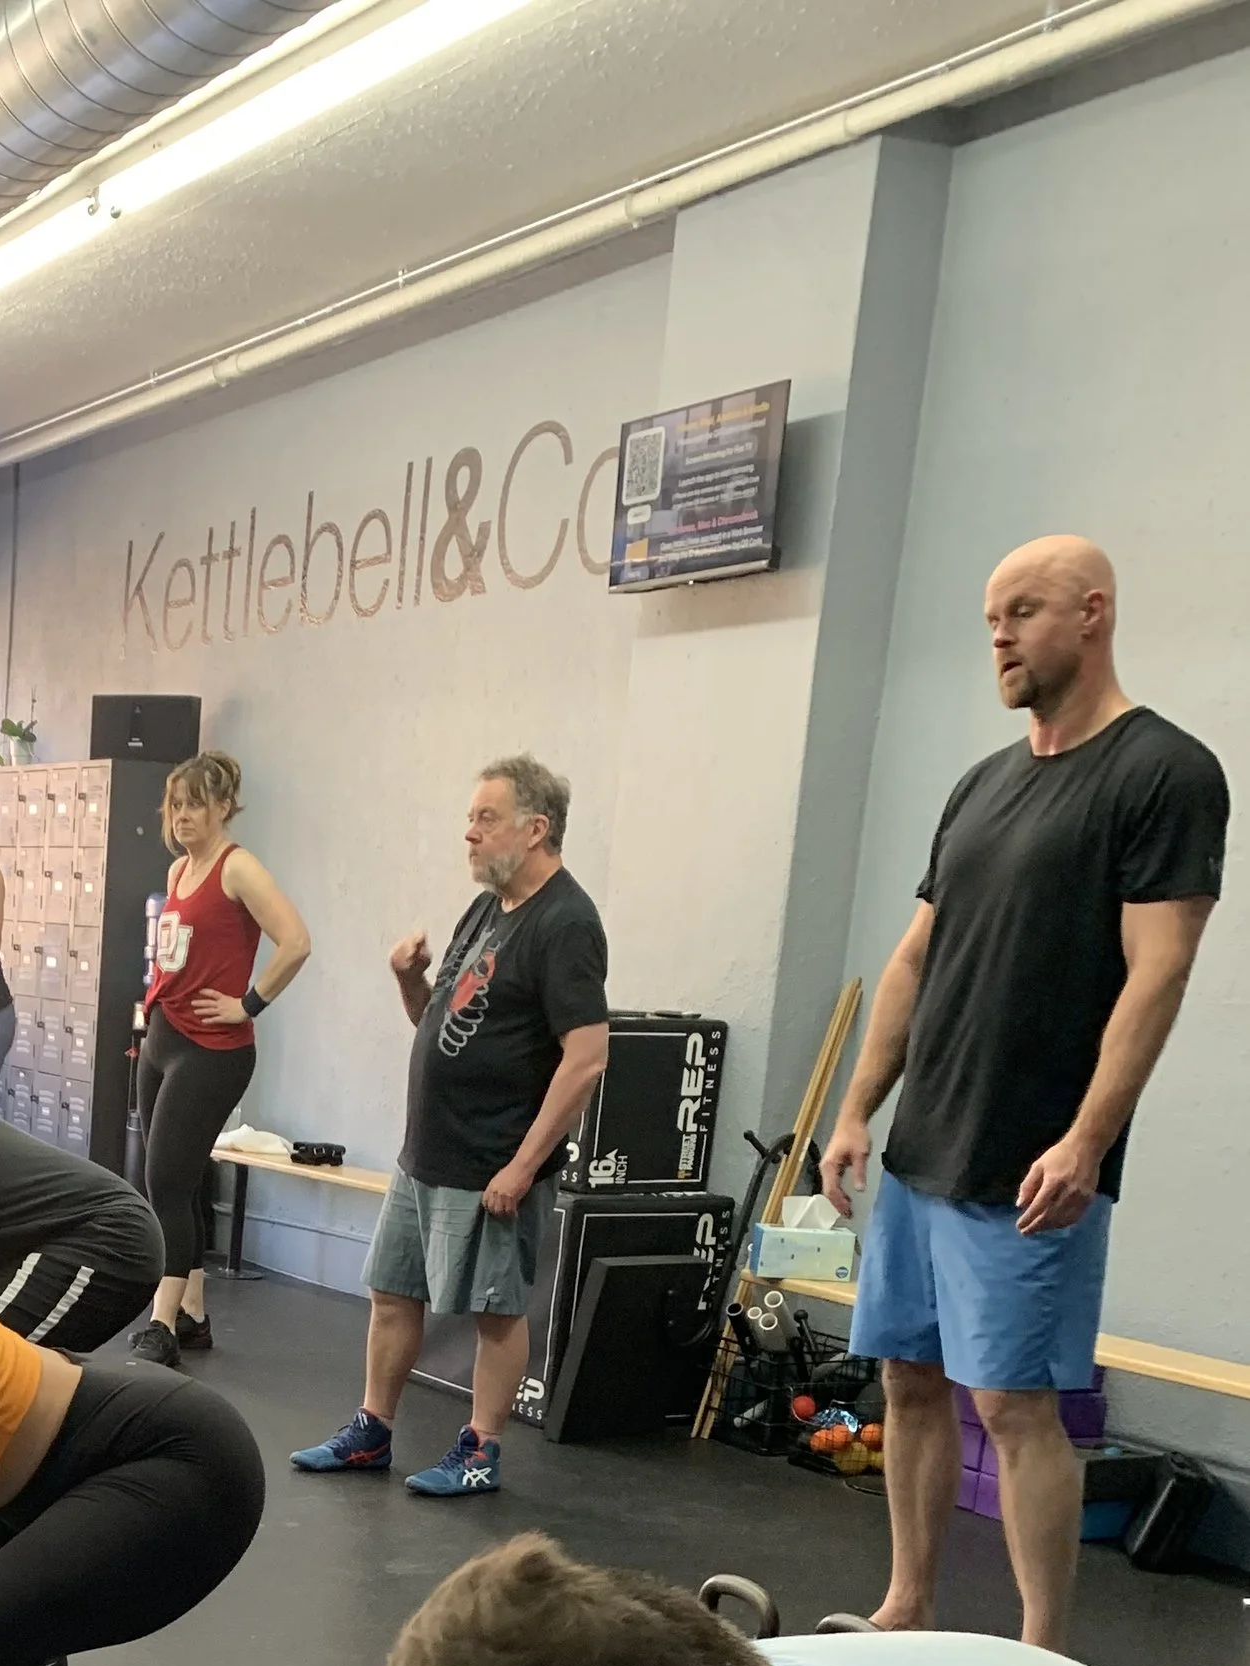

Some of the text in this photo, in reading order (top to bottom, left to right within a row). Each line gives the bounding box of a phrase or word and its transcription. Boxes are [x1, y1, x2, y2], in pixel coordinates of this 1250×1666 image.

[677, 1032, 707, 1133] REP
[700, 1030, 721, 1132] FITNESS
[588, 1159, 617, 1189] 16
[614, 1155, 628, 1184] INCH
